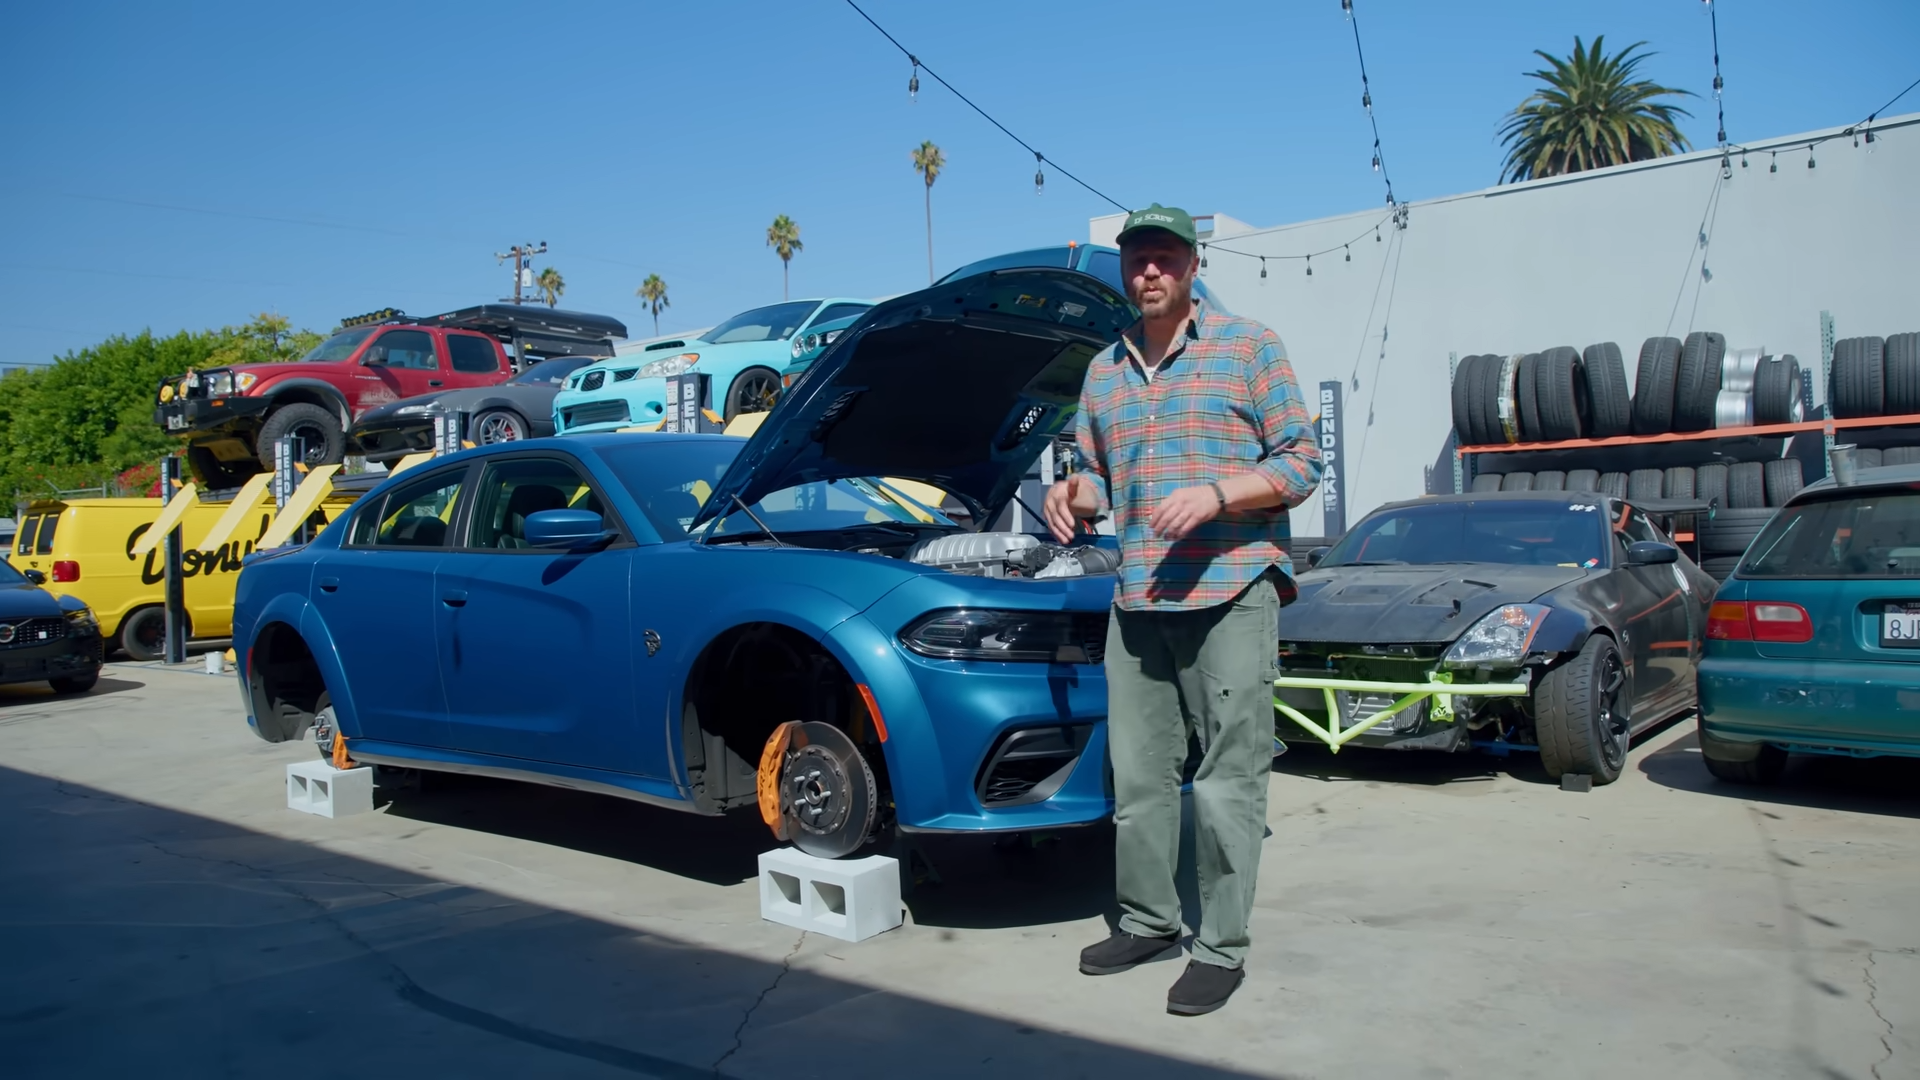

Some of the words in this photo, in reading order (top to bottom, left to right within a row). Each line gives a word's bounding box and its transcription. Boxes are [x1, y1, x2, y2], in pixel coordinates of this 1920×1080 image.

[1144, 213, 1175, 223] SCREW
[1320, 389, 1338, 494] BENDPAK
[1890, 618, 1920, 639] 8J
